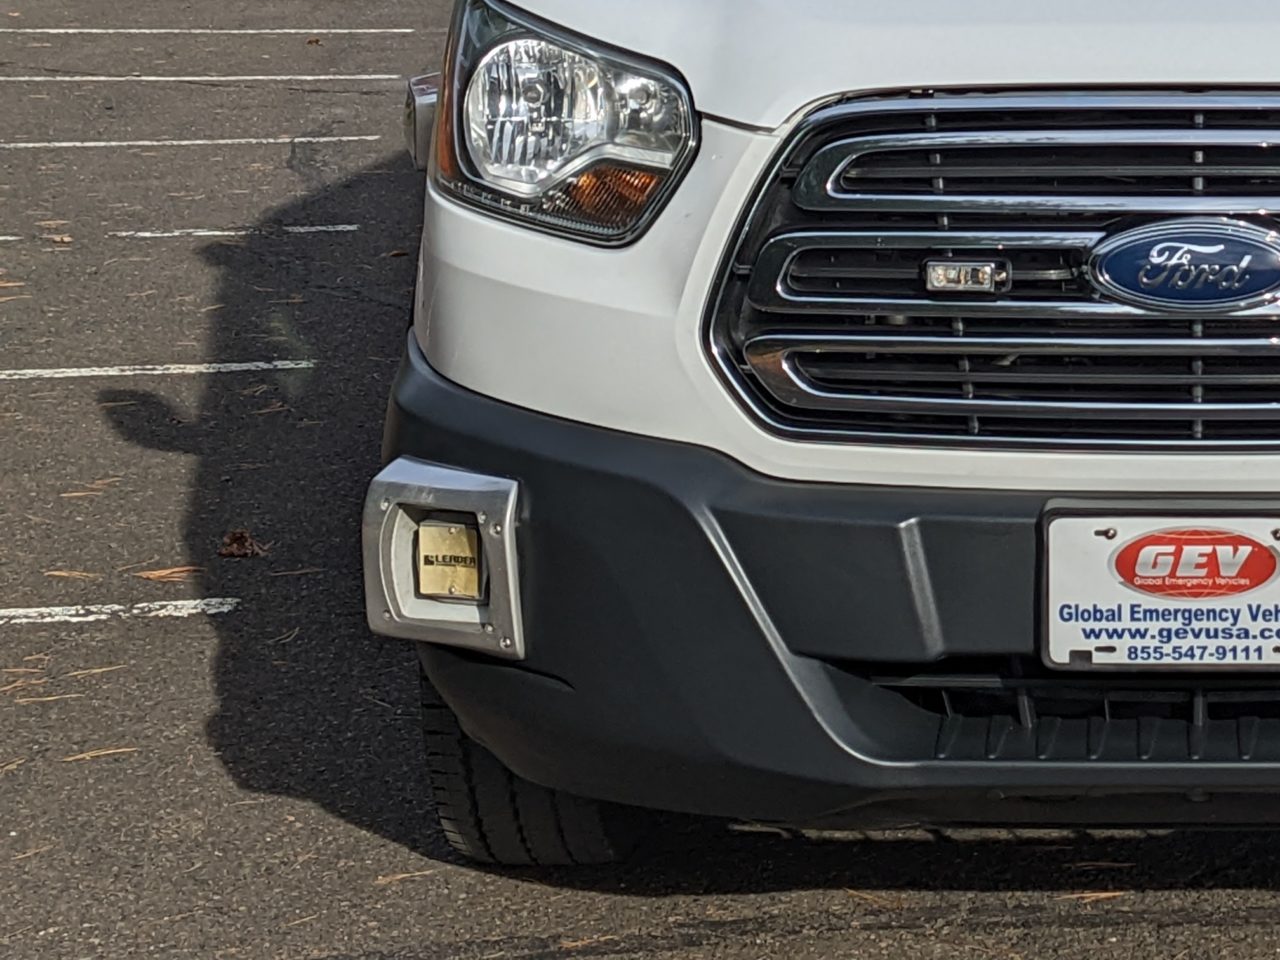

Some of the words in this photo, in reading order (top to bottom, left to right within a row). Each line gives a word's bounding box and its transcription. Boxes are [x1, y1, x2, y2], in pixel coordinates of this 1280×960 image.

[1138, 242, 1252, 289] Ford
[1135, 545, 1253, 577] GEV
[1134, 576, 1164, 585] Global
[1165, 576, 1213, 587] Emergency
[1215, 576, 1250, 585] Vehicles
[1058, 603, 1122, 623] Global
[1129, 603, 1241, 627] Emergency
[1127, 645, 1264, 661] 855-547-9111
